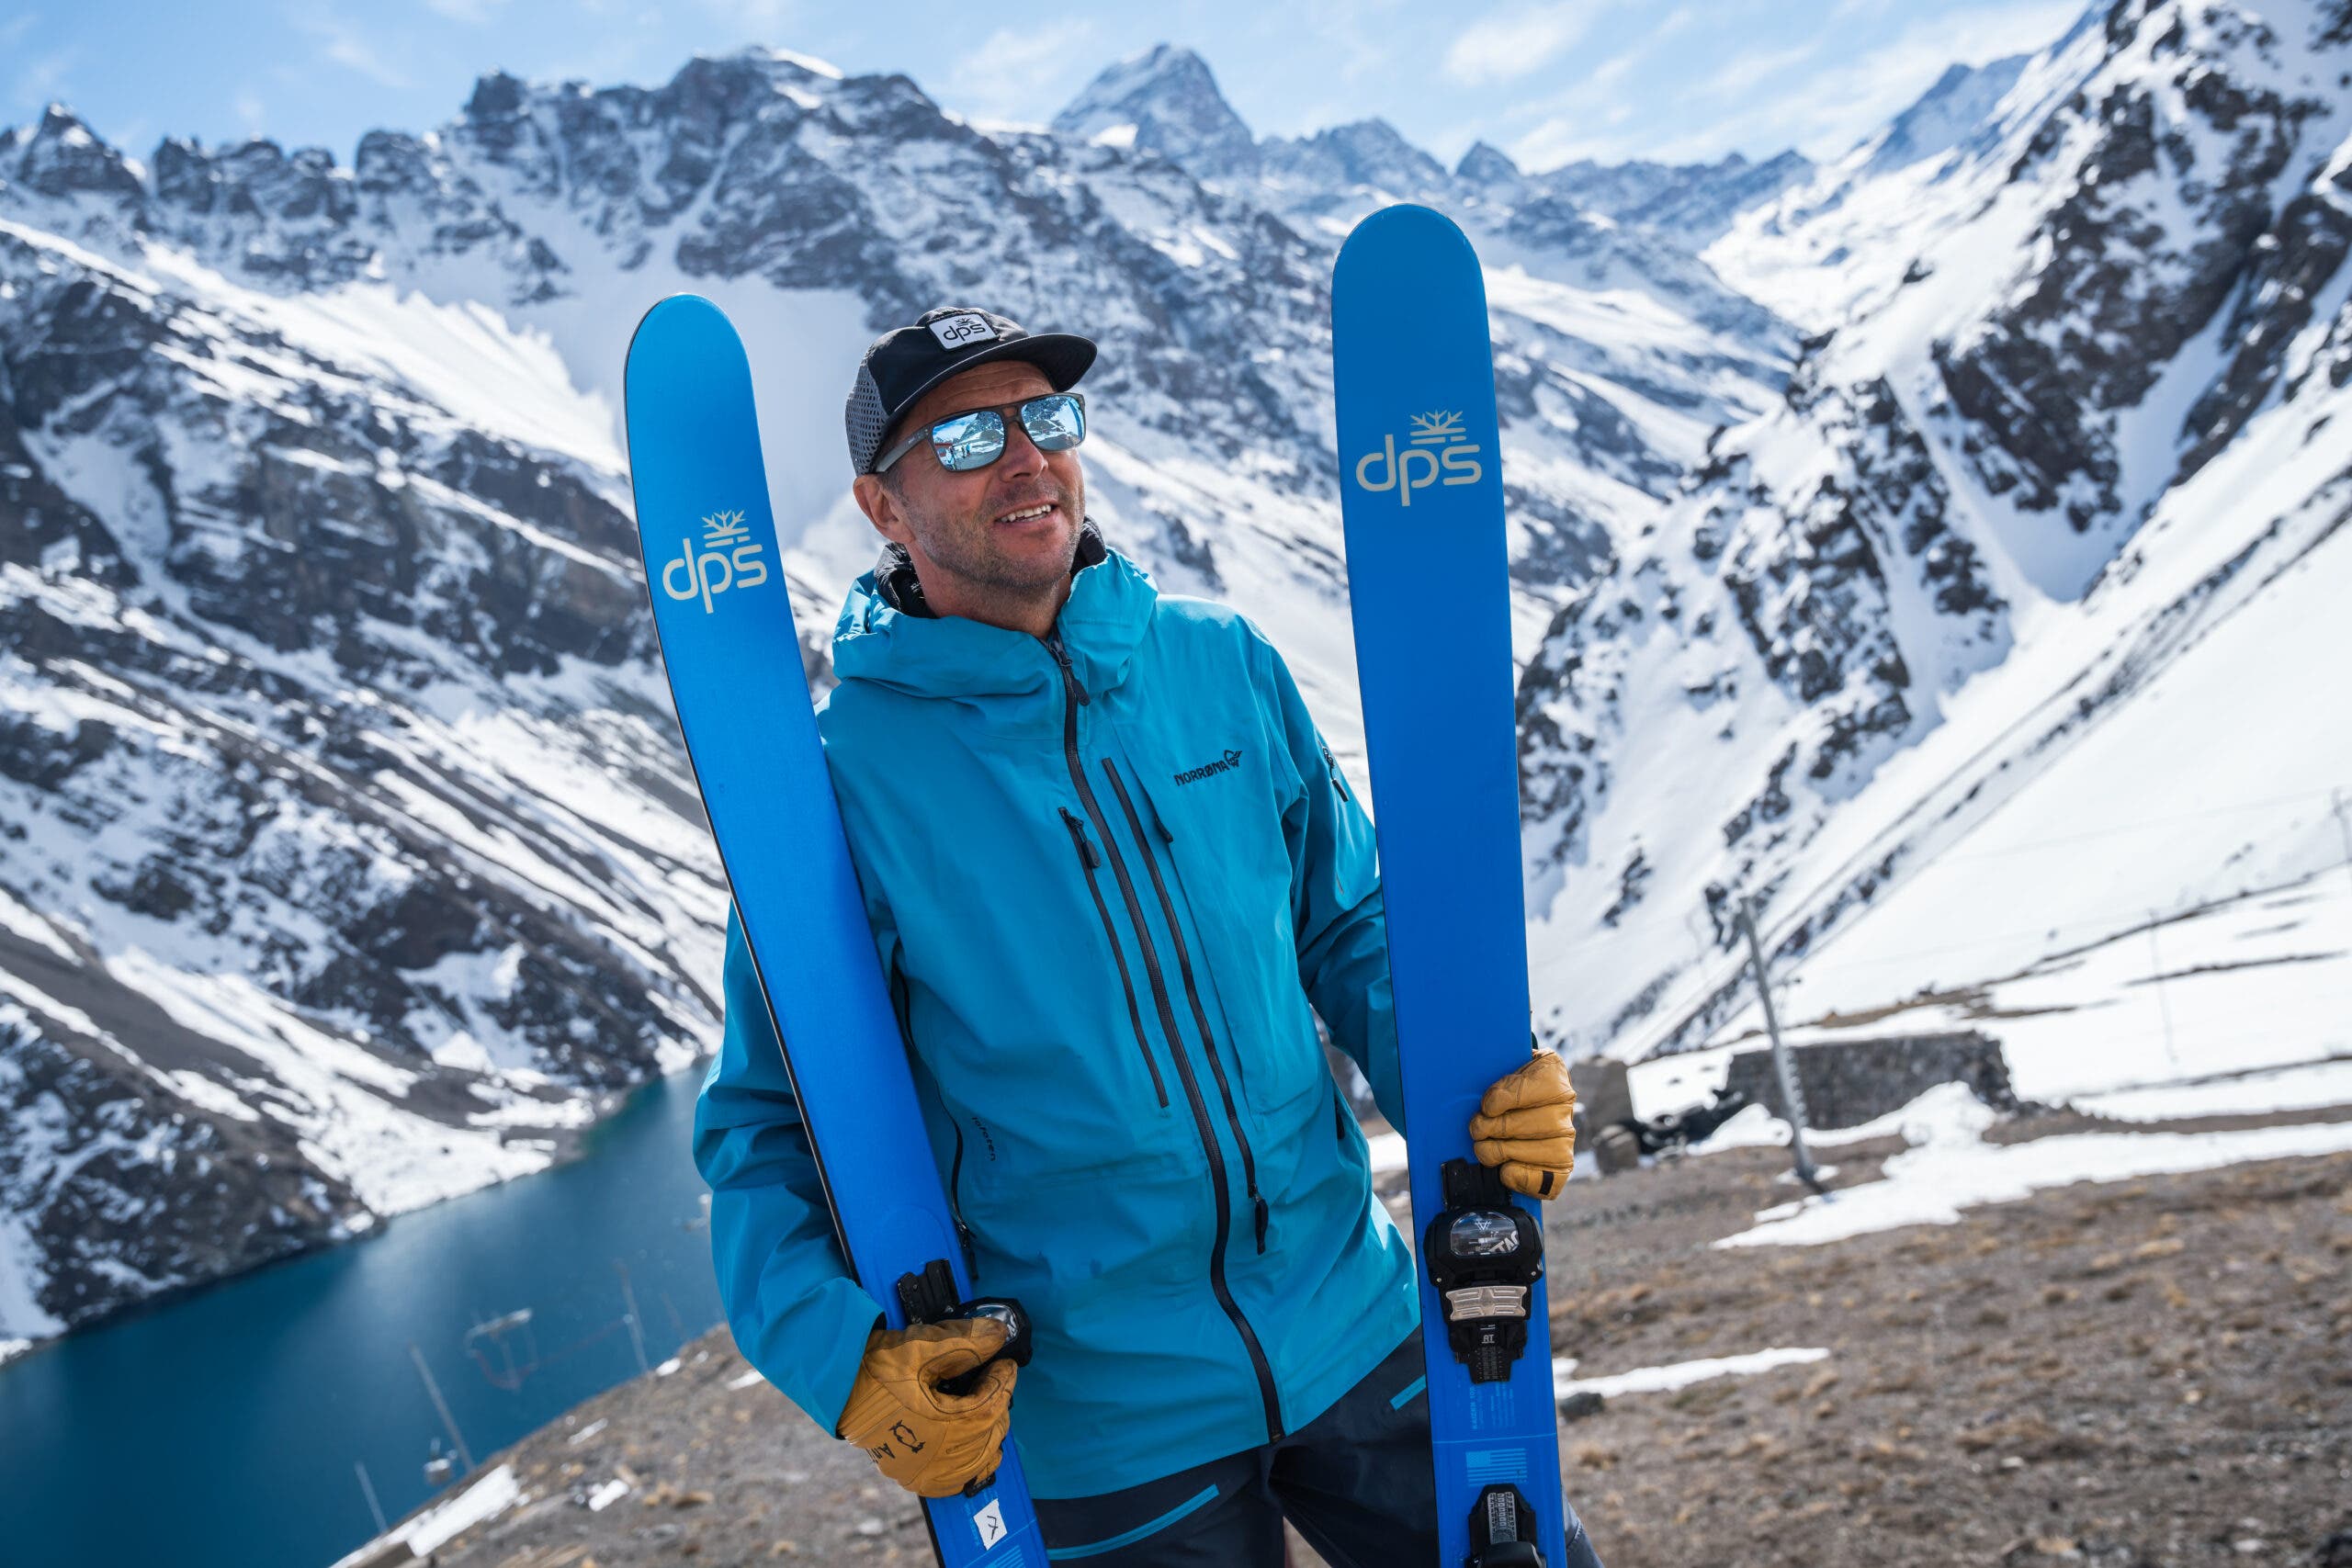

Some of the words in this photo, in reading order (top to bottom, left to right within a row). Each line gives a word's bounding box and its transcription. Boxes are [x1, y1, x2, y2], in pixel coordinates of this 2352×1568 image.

[943, 323, 987, 342] dps
[1355, 434, 1482, 507] dps
[662, 537, 768, 615] dps
[1173, 760, 1230, 787] NORRØNA
